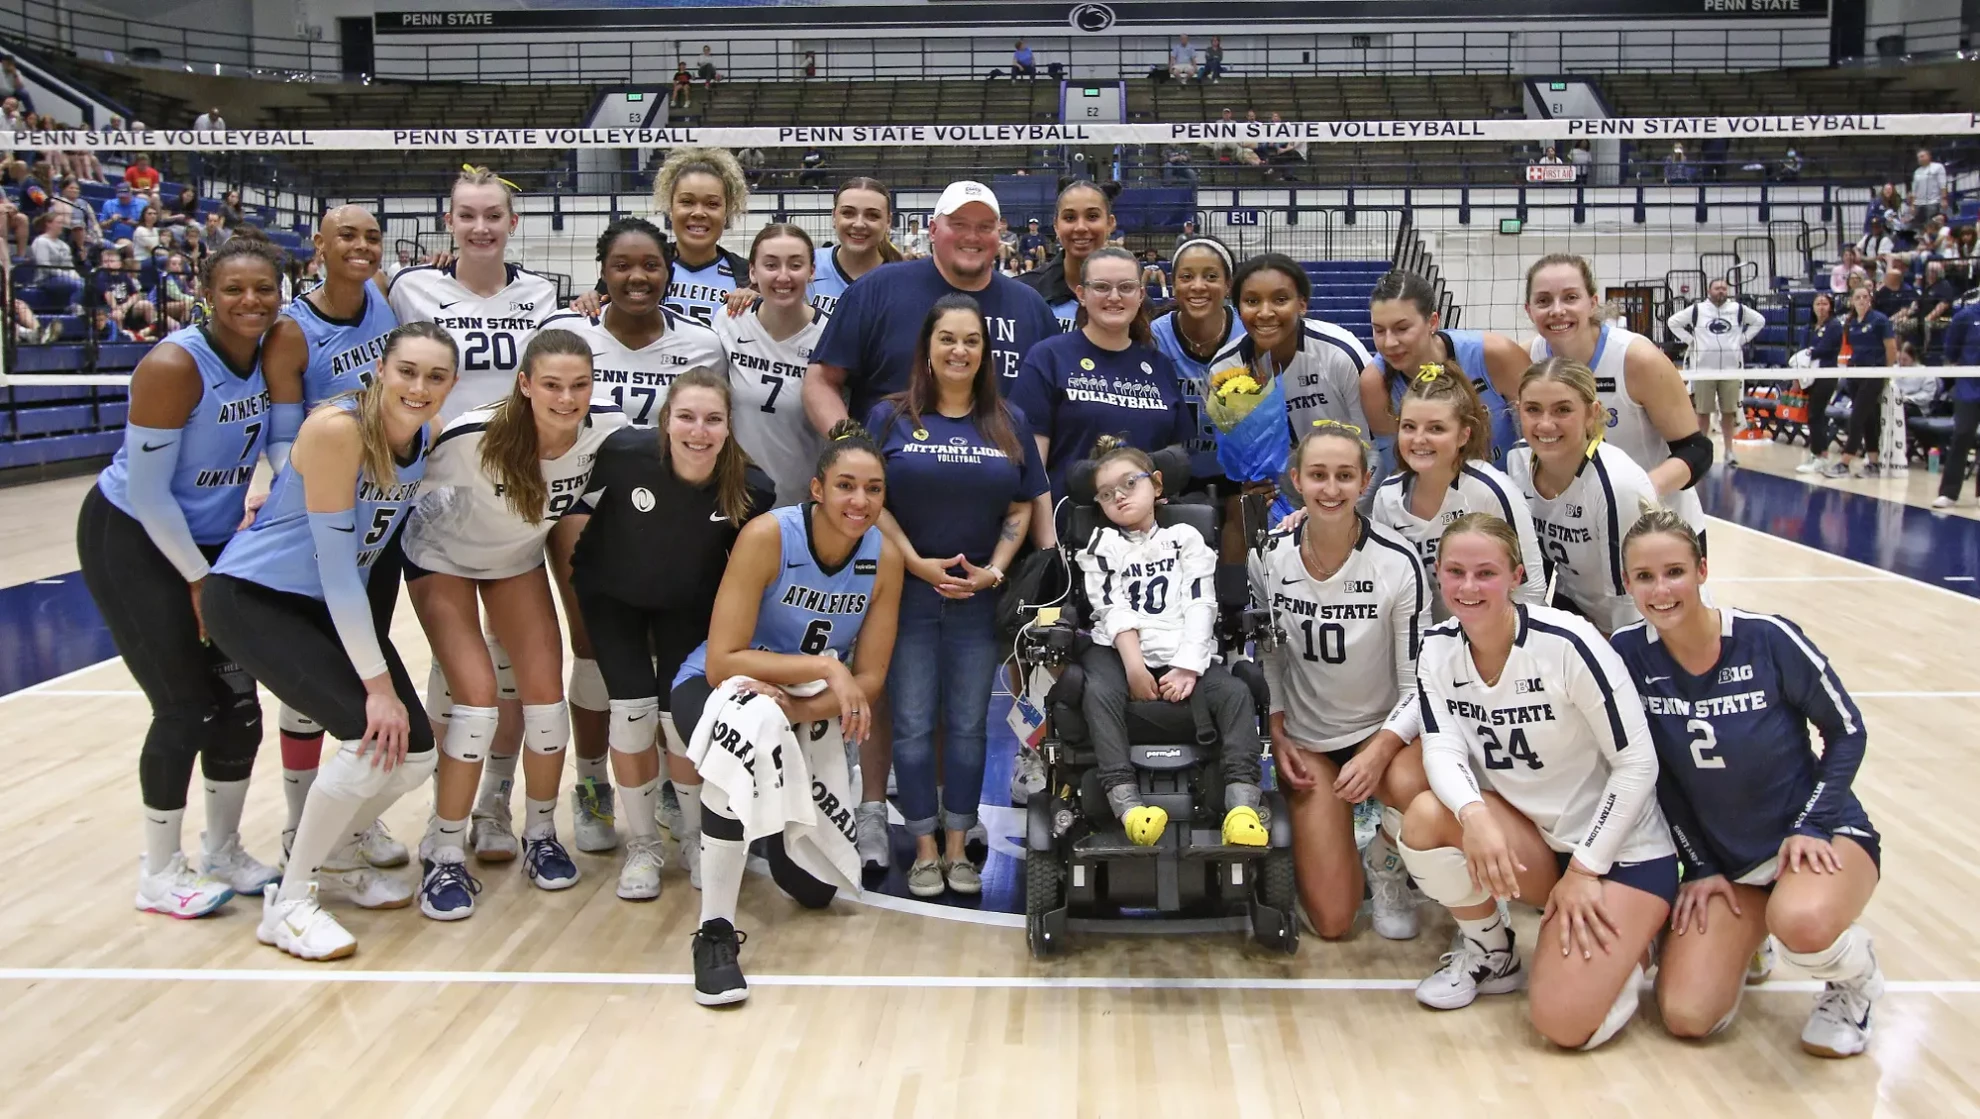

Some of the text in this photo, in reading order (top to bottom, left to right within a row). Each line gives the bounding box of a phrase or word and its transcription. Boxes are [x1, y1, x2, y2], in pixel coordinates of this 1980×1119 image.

[1704, 0, 1800, 11] PENN STATE
[402, 13, 493, 26] PENN STATE
[629, 113, 641, 123] E3
[1087, 107, 1099, 117] E2
[1552, 103, 1563, 113] E1
[779, 125, 1089, 142] PENN STATE VOLLEYBALL
[1171, 121, 1485, 138] PENN STATE VOLLEYBALL
[1568, 115, 1886, 135] PENN STATE VOLLEYBALL
[13, 131, 314, 145] PENN STATE VOLLEYBALL
[394, 129, 698, 145] PENN STATE VOLLEYBALL
[1562, 169, 1574, 178] AID
[1231, 212, 1255, 224] E1L
[668, 282, 729, 305] HLETES
[434, 316, 537, 331] PENN STATE
[332, 332, 390, 377] ATHLET
[465, 332, 517, 371] 20
[730, 351, 808, 379] PENN STAT
[593, 368, 679, 386] ENN STAT
[760, 374, 784, 414] 7
[1066, 388, 1168, 410] VOLLEYBALL
[1285, 393, 1329, 413] STATE
[218, 389, 271, 423] ATHLETE
[610, 386, 656, 425] 17
[239, 422, 262, 461] 7
[903, 442, 968, 455] NITTANY
[937, 454, 982, 464] VOLLEYBALL
[195, 466, 252, 487] UNLIM
[551, 468, 593, 493] STAT
[364, 507, 398, 546] 5
[1548, 523, 1592, 543] STATE
[781, 584, 868, 614] ATHLETES
[1128, 575, 1169, 614] 10
[1273, 593, 1378, 619] PENN STATE
[800, 619, 834, 655] 6
[1301, 619, 1346, 664] 10
[1491, 703, 1556, 726] STATE
[1695, 690, 1767, 718] STATE
[1477, 725, 1544, 770] 24
[1686, 719, 1726, 769] 2
[1584, 792, 1617, 848] NITTANY LIONS
